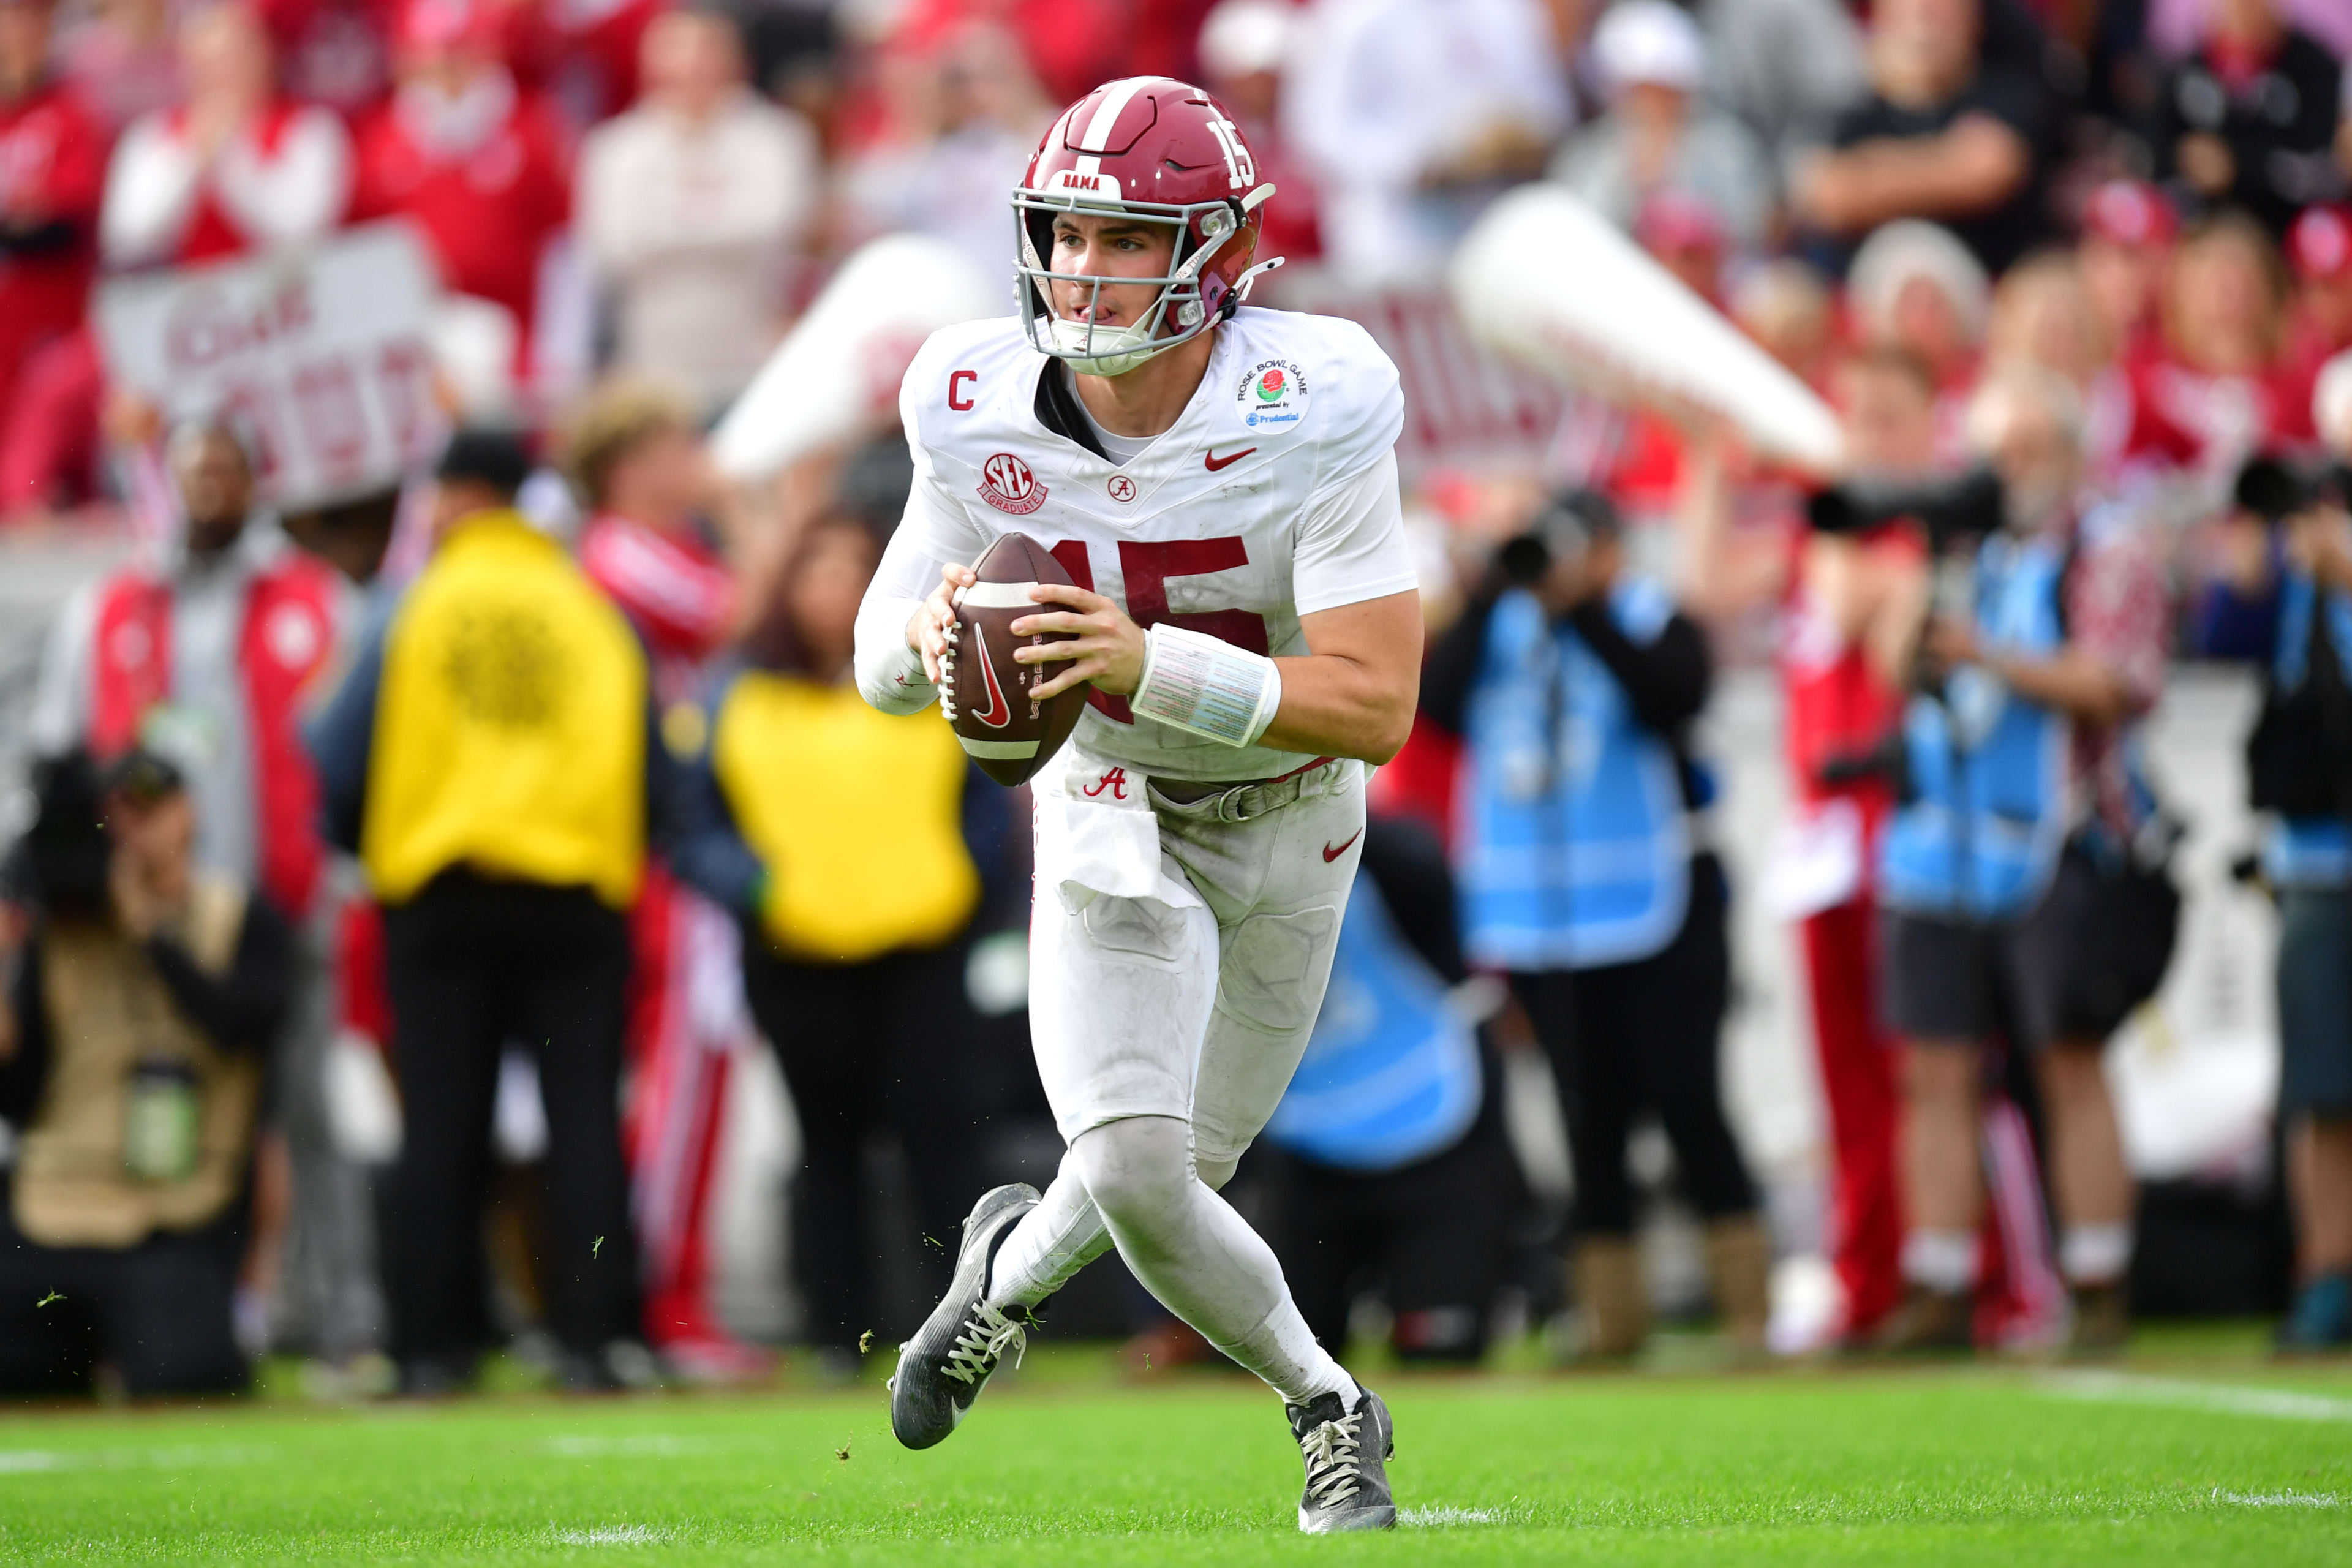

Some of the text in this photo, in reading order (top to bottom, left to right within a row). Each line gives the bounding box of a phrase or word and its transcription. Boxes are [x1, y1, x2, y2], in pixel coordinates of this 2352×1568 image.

[1206, 119, 1255, 189] 15
[1063, 174, 1100, 190] BAMA
[948, 370, 978, 411] C
[1237, 360, 1308, 401] ROSE BOWL GAME
[1256, 401, 1282, 411] presented
[1259, 413, 1300, 423] Prudential
[986, 455, 1031, 499] SEC
[1113, 480, 1131, 496] A
[988, 495, 1041, 513] GRADUATE
[1083, 766, 1128, 800] A
